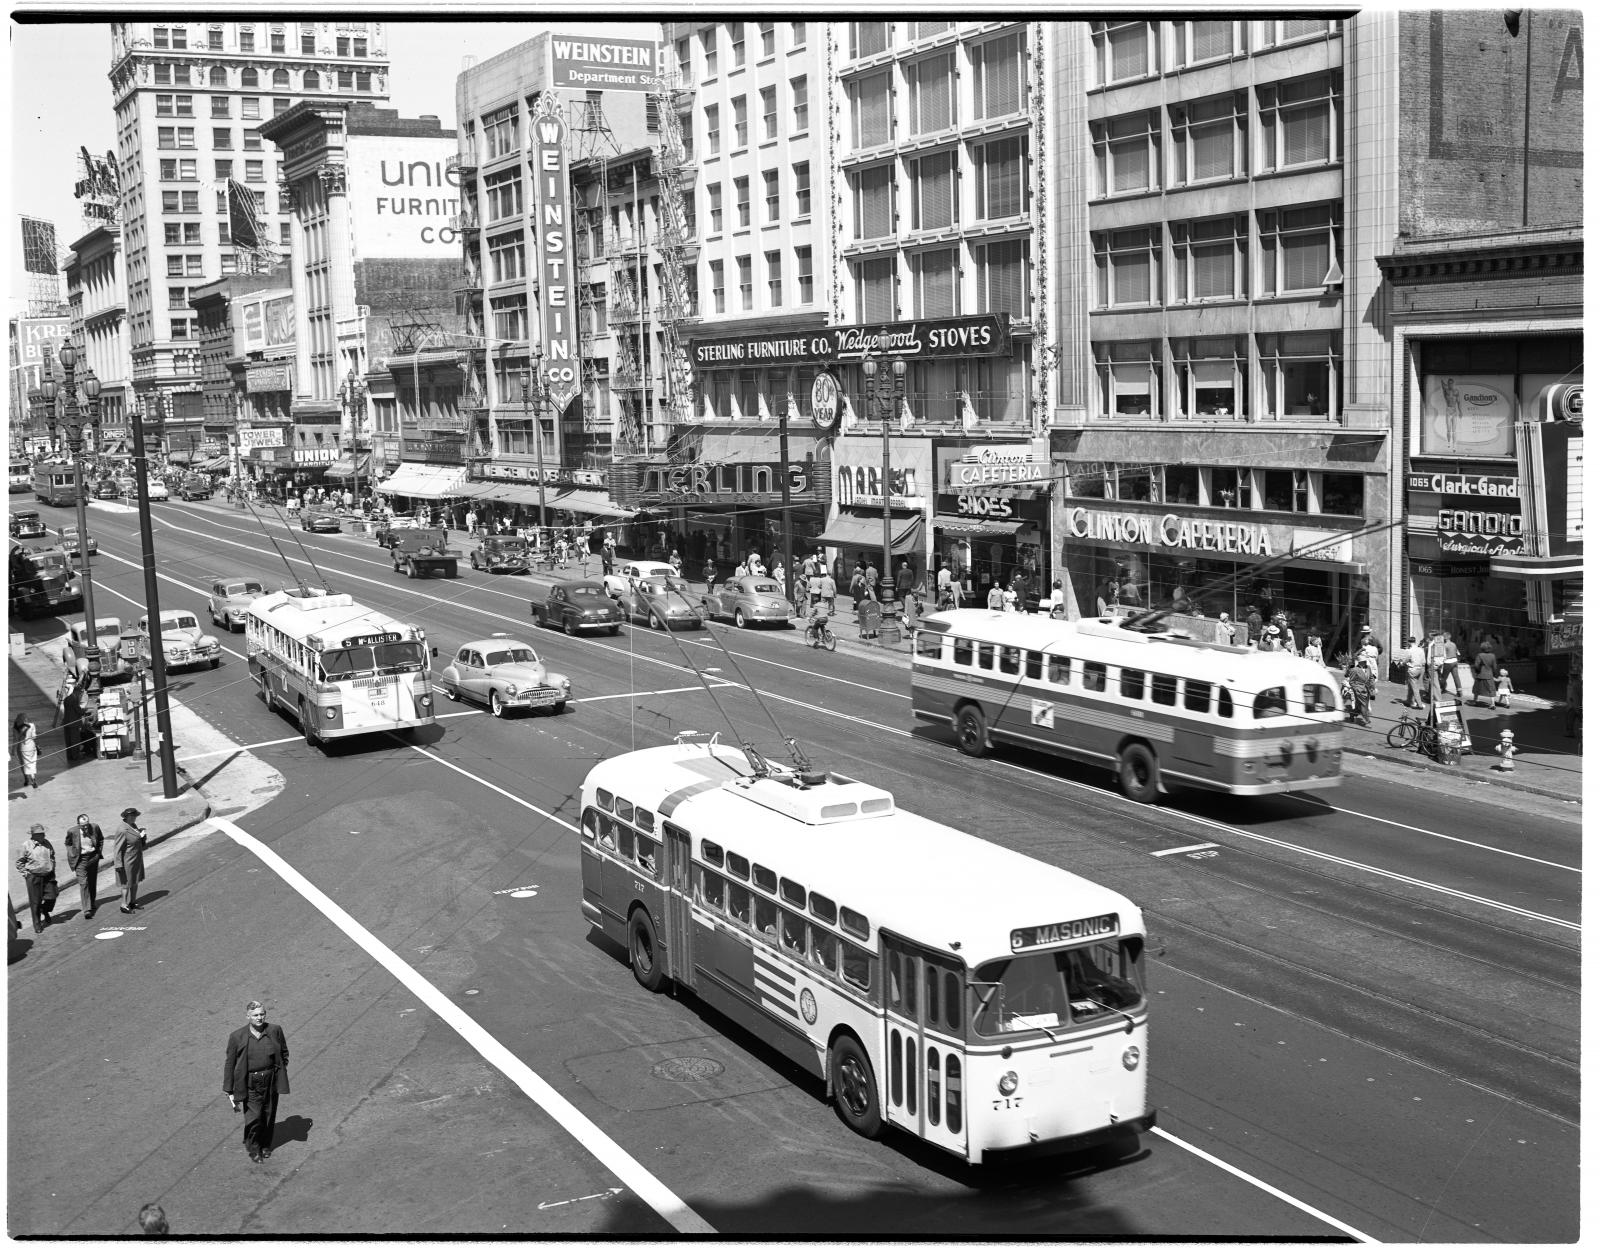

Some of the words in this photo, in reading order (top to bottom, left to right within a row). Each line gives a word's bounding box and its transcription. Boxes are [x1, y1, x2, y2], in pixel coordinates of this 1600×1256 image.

[553, 40, 650, 66] WEINSTEIN
[569, 69, 636, 85] Department
[540, 122, 569, 360] WEINSTEIN
[697, 344, 745, 362] STERLING
[748, 338, 807, 359] FURNITURE
[811, 337, 832, 354] CO.
[835, 323, 922, 355] Wedgeood
[929, 325, 991, 348] STOVES
[242, 431, 275, 440] TOWER
[294, 449, 340, 462] UNION
[638, 464, 807, 494] STERLING
[960, 465, 1043, 485] CAFETERIA
[1409, 477, 1429, 488] 1065
[957, 495, 1013, 517] SHOES
[633, 880, 645, 892] 717
[1011, 929, 1024, 948] 6
[1035, 916, 1111, 944] MASONIC
[992, 1096, 1024, 1111] 717
